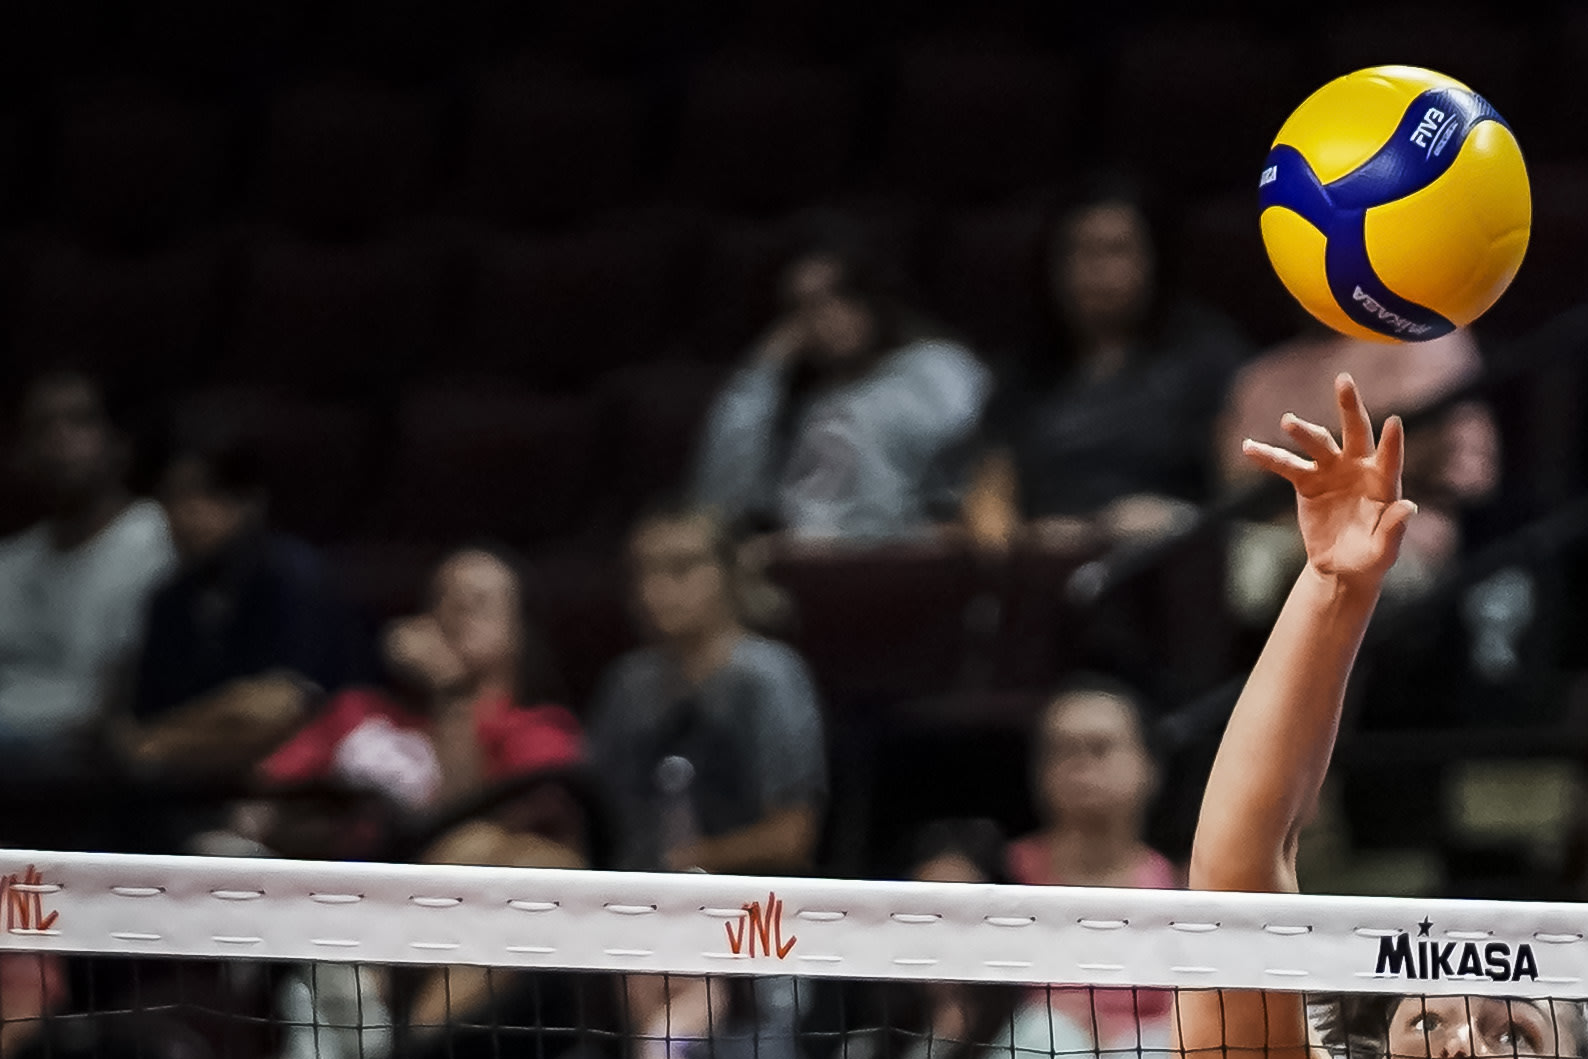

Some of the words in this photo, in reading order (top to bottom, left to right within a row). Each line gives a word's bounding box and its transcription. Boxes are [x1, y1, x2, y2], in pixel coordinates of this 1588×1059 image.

[1409, 107, 1445, 148] FIVB
[725, 890, 797, 960] VNL
[1375, 915, 1539, 982] MIKASA
